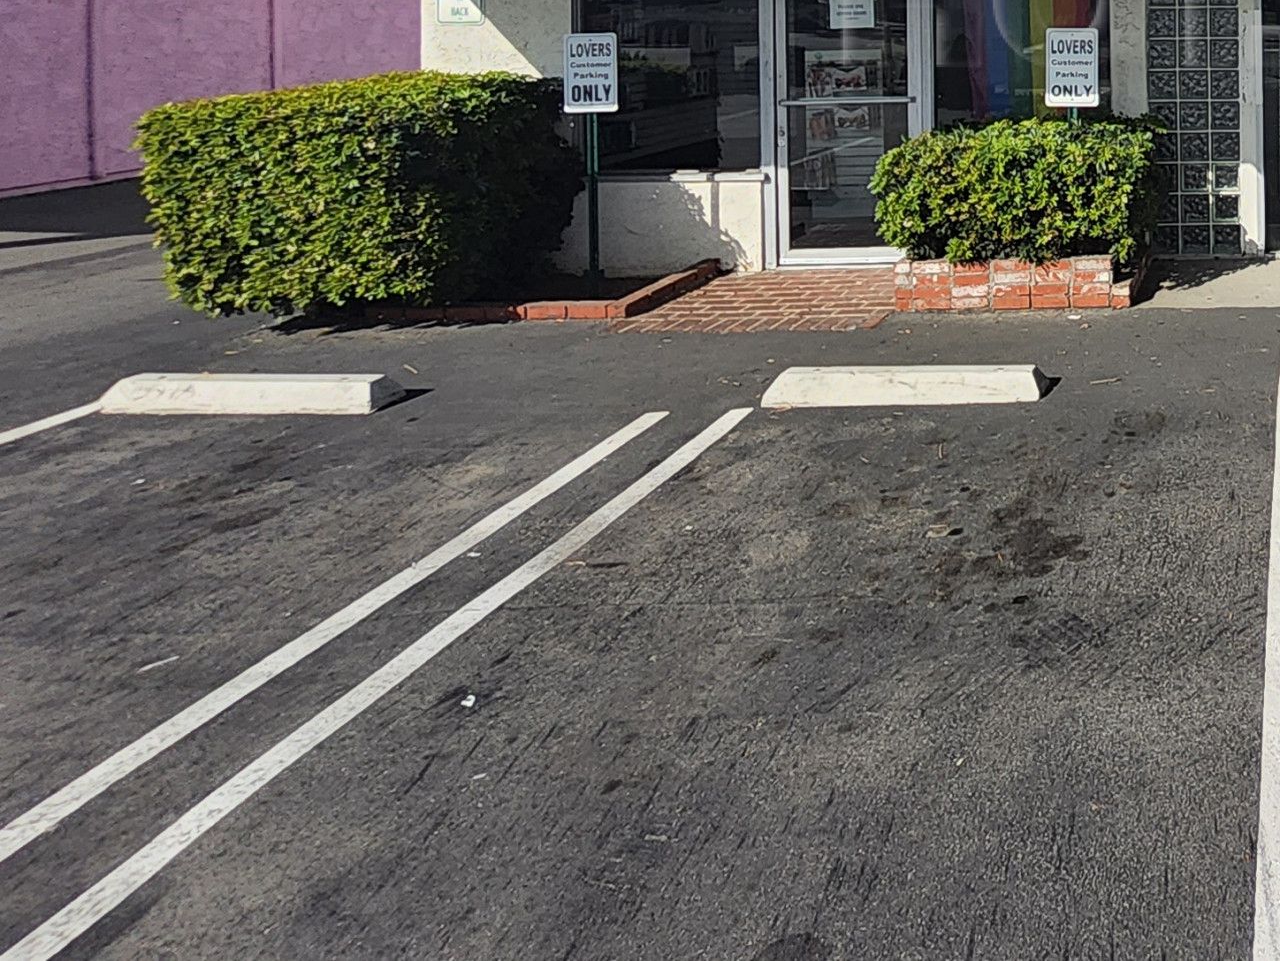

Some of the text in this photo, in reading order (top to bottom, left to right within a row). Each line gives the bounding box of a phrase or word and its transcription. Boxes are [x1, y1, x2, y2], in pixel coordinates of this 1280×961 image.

[570, 42, 612, 58] LOVERS
[1051, 39, 1094, 55] LOVERS
[570, 61, 612, 69] Customer
[574, 72, 609, 80] Parking
[1055, 71, 1089, 79] Parking
[571, 84, 612, 102] ONLY
[1051, 85, 1093, 97] ONLY
